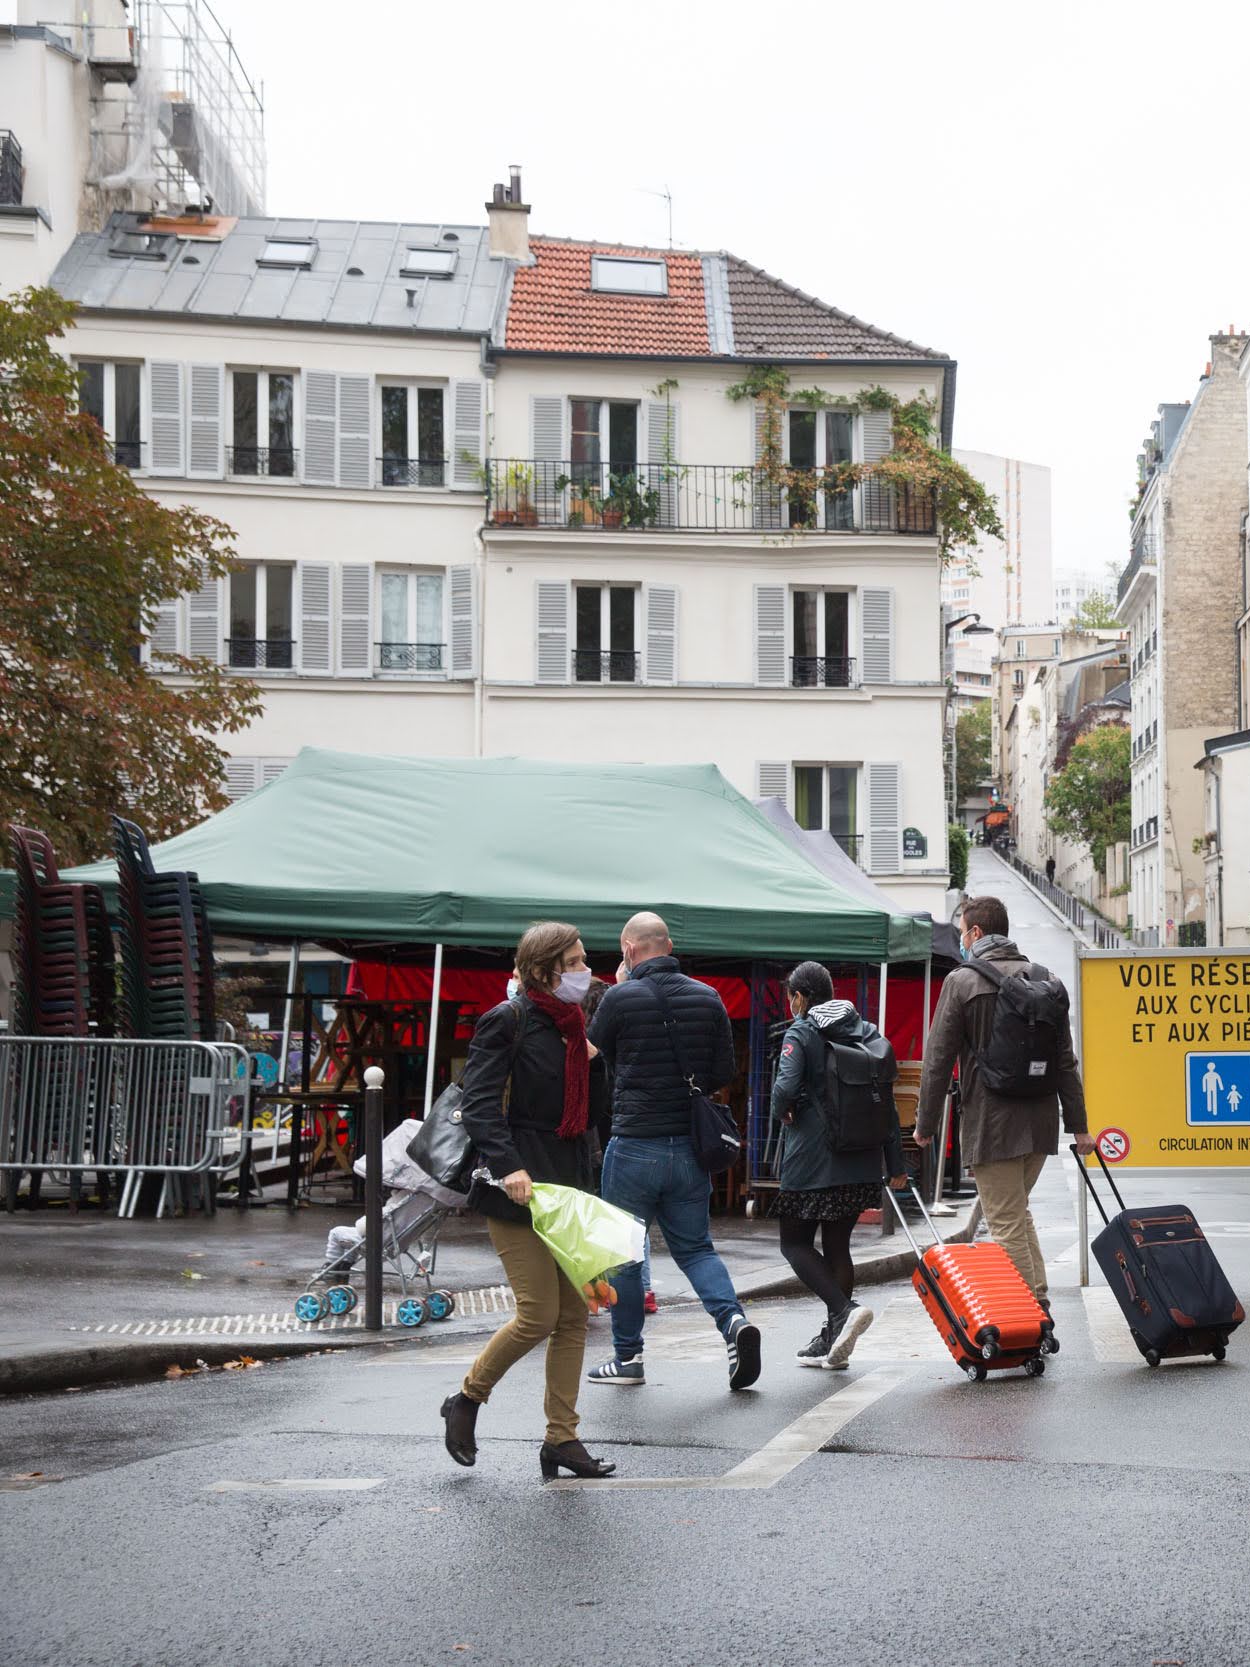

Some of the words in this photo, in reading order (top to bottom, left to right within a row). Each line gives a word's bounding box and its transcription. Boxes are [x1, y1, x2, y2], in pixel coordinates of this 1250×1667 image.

[1119, 963, 1177, 987] VOIE
[1136, 995, 1178, 1015] AUX
[1132, 1023, 1156, 1043] ET
[1168, 1022, 1211, 1042] AUX
[1159, 1137, 1233, 1151] CIRCULATION
